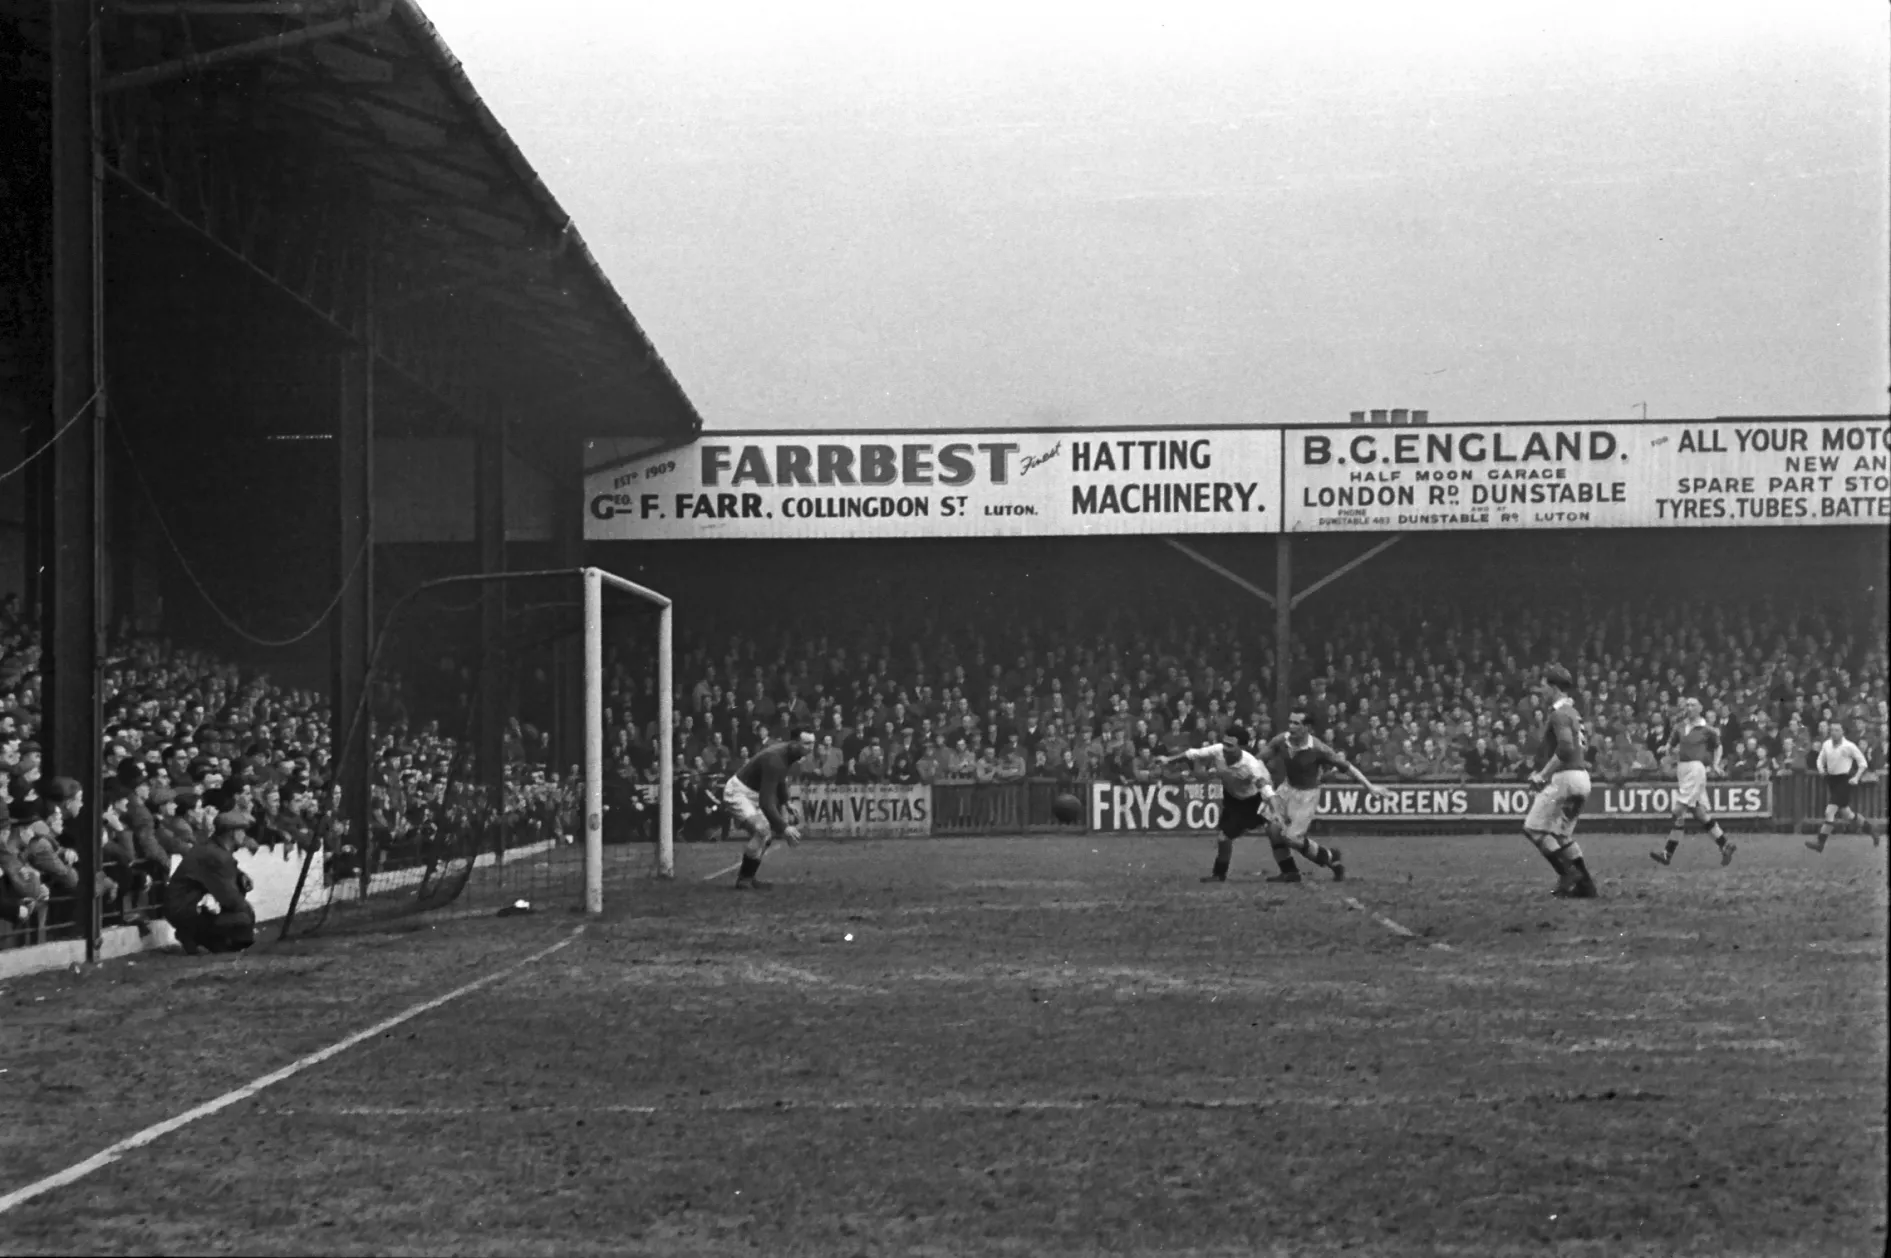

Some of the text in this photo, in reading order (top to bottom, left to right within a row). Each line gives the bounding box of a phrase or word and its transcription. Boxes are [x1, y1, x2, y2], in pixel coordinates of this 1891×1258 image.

[1677, 428, 1728, 453] ALL
[1735, 427, 1809, 452] YOUR
[700, 441, 1021, 487] FARRBEST
[1019, 440, 1062, 476] Finest
[1071, 439, 1211, 472] HATTING
[1785, 455, 1840, 473] NEW
[645, 460, 676, 480] 1909
[1349, 467, 1567, 483] HALF MOON GARAGE
[1071, 481, 1267, 515] MACHINERY.
[1303, 484, 1415, 508] LONDON
[1472, 482, 1627, 504] DUNSTABLE
[1677, 476, 1755, 494] SPARE
[1768, 476, 1834, 493] PART
[640, 493, 667, 520] F.
[675, 492, 773, 520] FARR.
[782, 496, 929, 519] COLLINGDON
[1397, 513, 1490, 525] DUNSTABLE
[1534, 511, 1591, 523] LUTON
[850, 796, 927, 823] VESTAS
